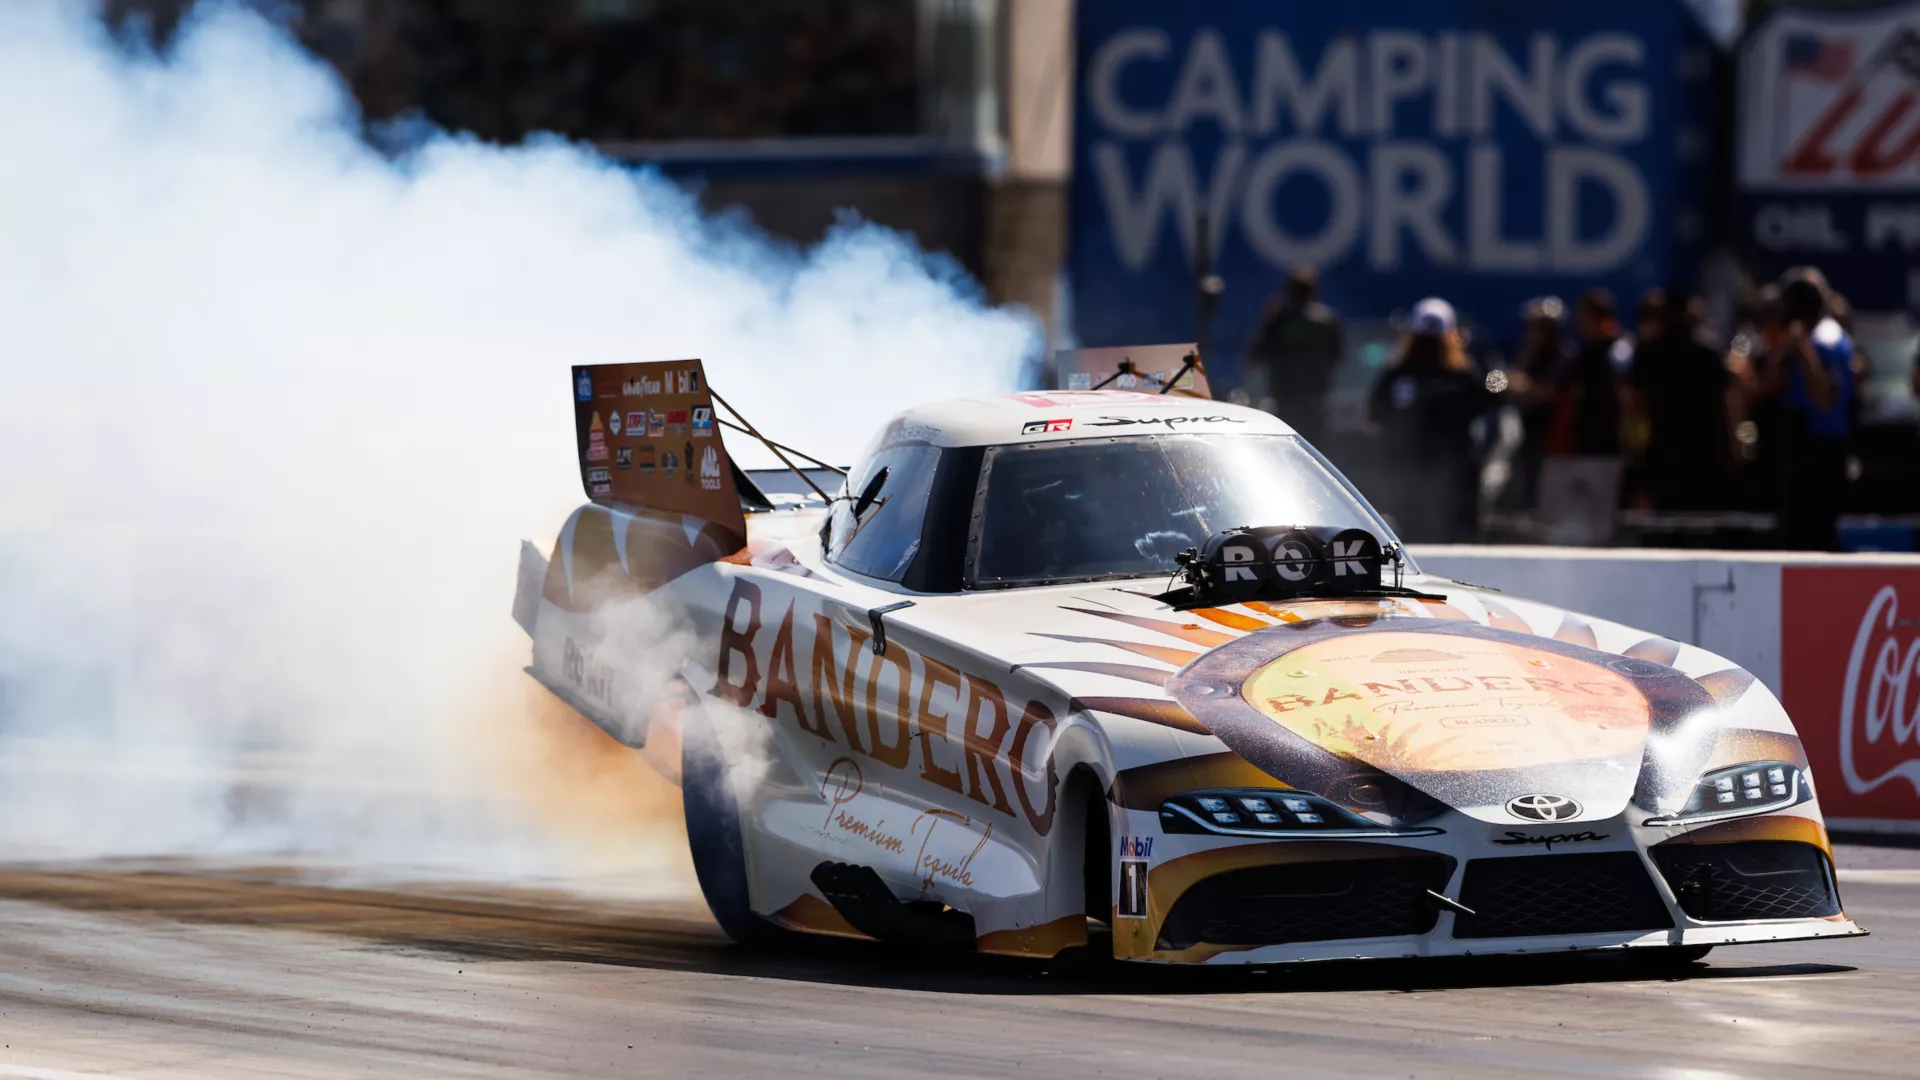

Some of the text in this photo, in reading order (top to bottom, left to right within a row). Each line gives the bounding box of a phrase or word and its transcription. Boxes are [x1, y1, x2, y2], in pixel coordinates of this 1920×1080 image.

[1088, 28, 1649, 141] CAMPING
[1092, 141, 1652, 272] WORLD
[1754, 203, 1849, 250] OIL
[1022, 415, 1246, 435] GR Supra
[701, 478, 722, 490] TOOLS
[707, 576, 1060, 838] BANDERO
[1266, 675, 1630, 714] BANDERO
[820, 756, 906, 854] Premium
[911, 808, 992, 899] Tequila
[1119, 836, 1153, 857] Mobil
[1491, 831, 1611, 851] Supra
